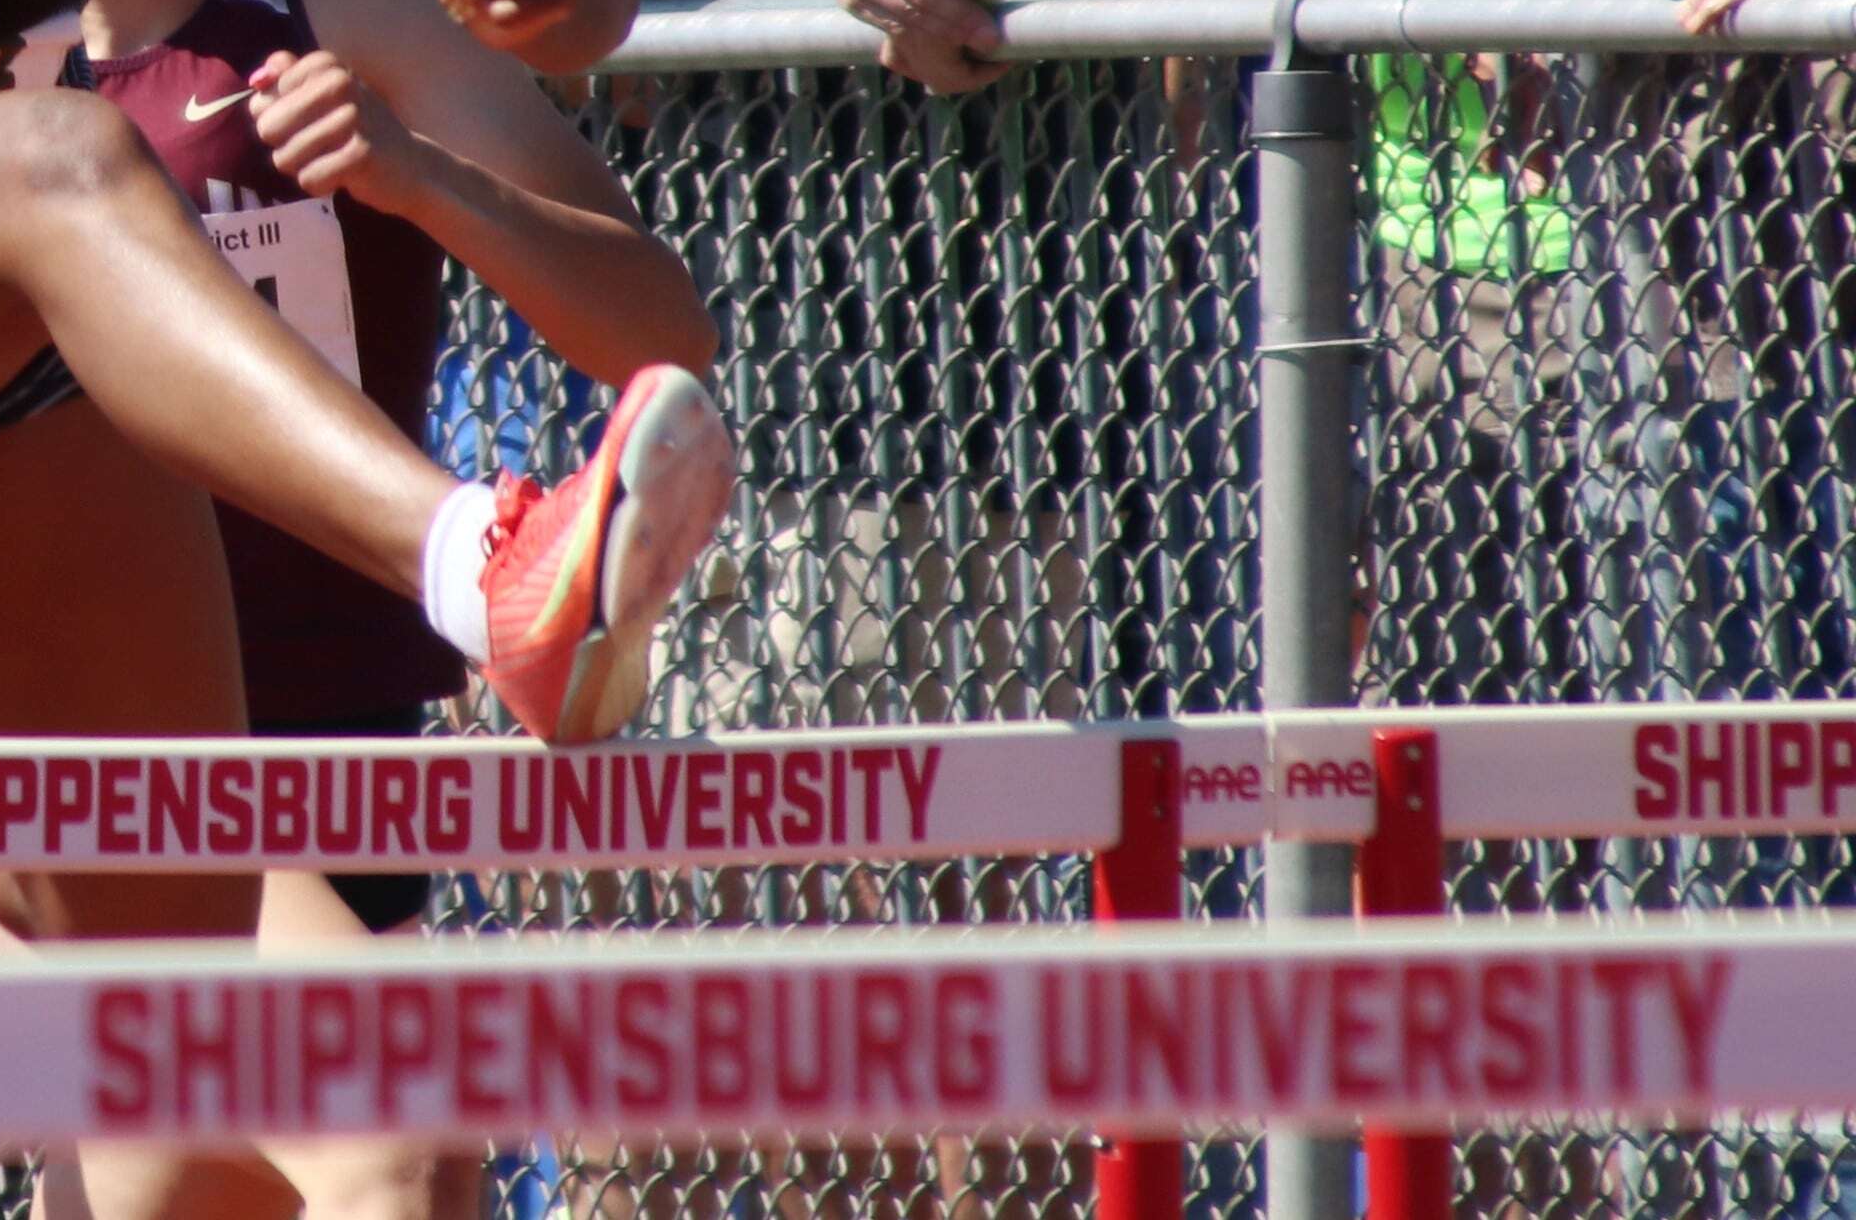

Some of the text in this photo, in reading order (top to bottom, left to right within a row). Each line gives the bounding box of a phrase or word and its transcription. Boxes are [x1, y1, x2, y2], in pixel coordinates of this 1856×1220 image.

[209, 227, 250, 251] ict
[497, 746, 942, 852] UNIVERSITY
[88, 952, 1734, 1127] SHIPPENSBURG UNIVERSITY
